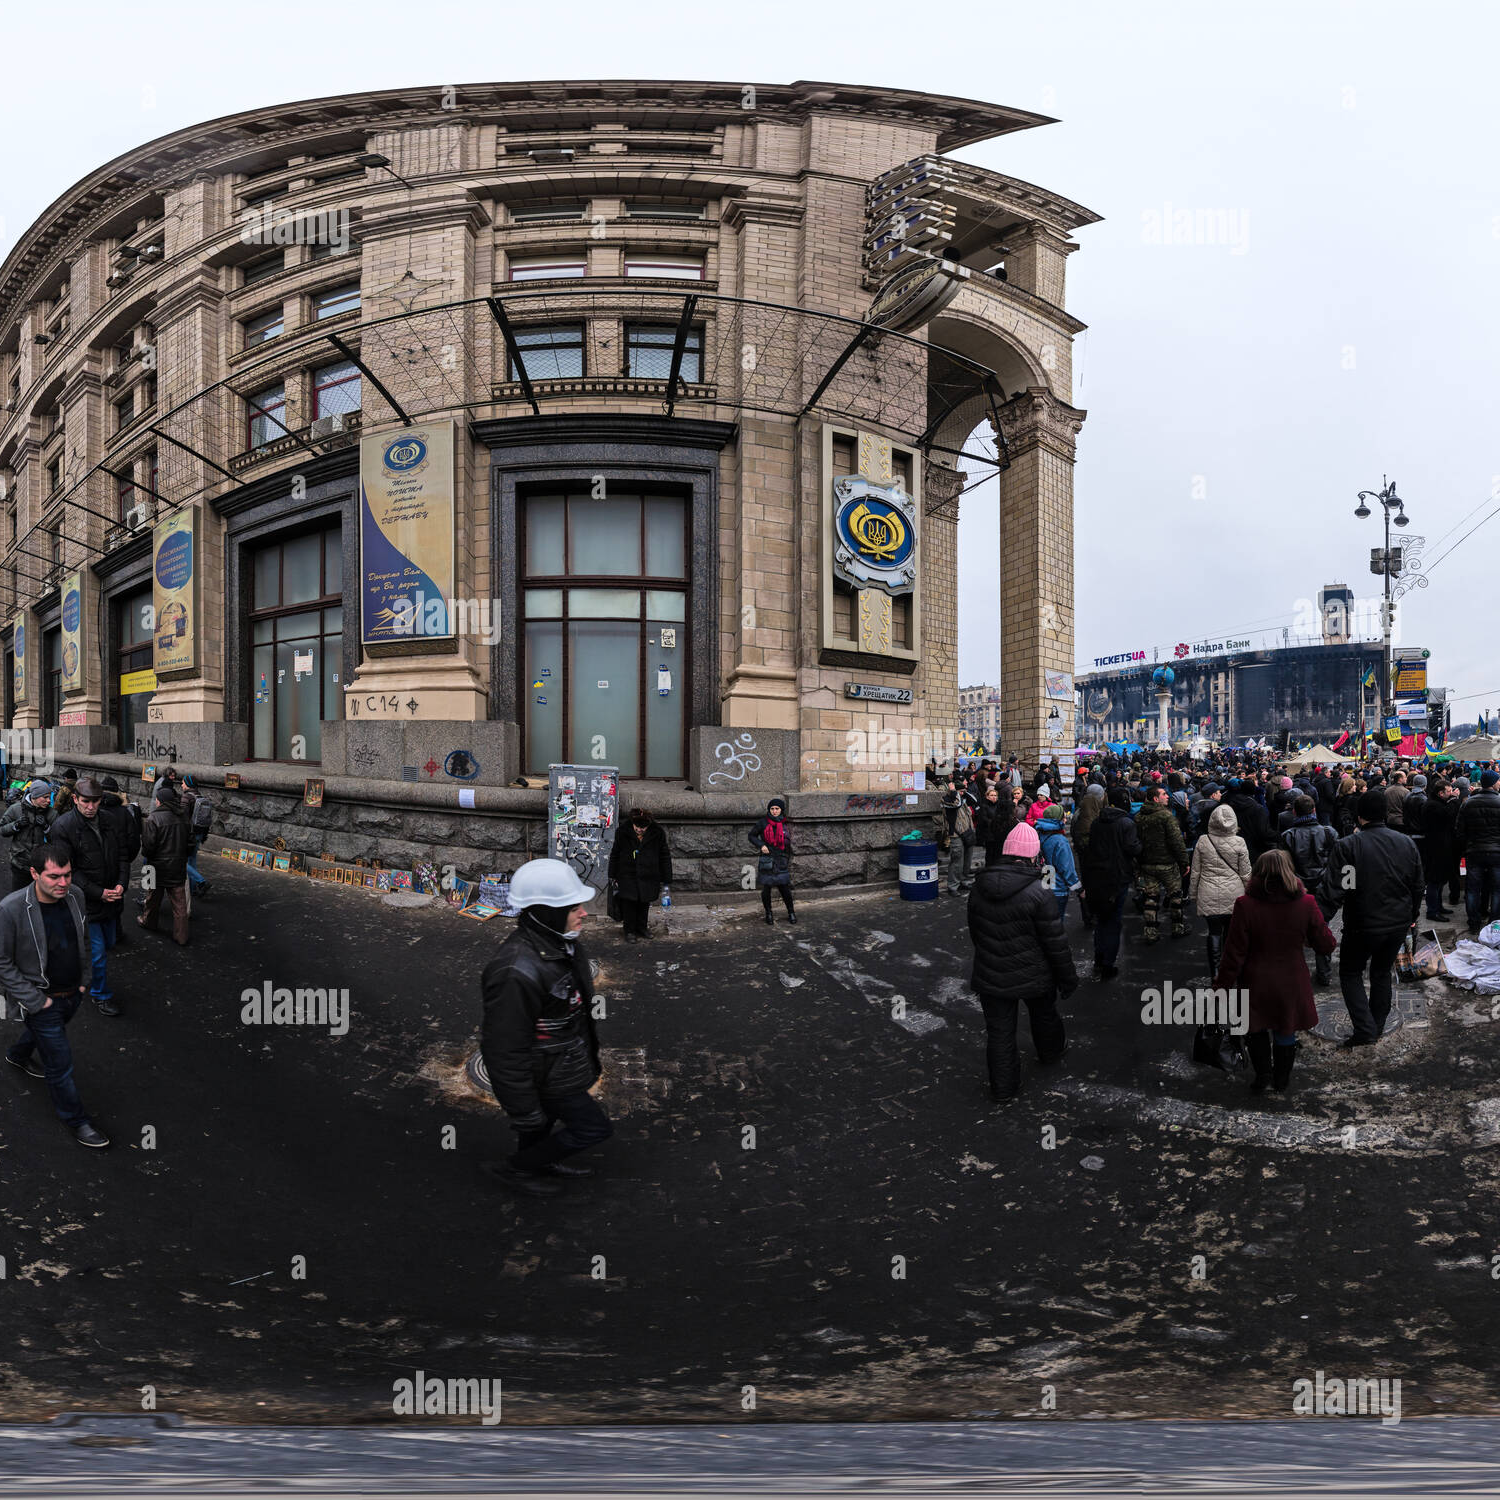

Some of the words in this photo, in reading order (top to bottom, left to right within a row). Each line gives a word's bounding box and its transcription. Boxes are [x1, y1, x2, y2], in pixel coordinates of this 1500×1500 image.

[1193, 643, 1223, 654] Надра
[1226, 639, 1250, 649] Банк
[1094, 650, 1146, 667] TICKETSUA
[863, 690, 897, 700] ХРЕЩАТИК
[897, 690, 910, 701] 22
